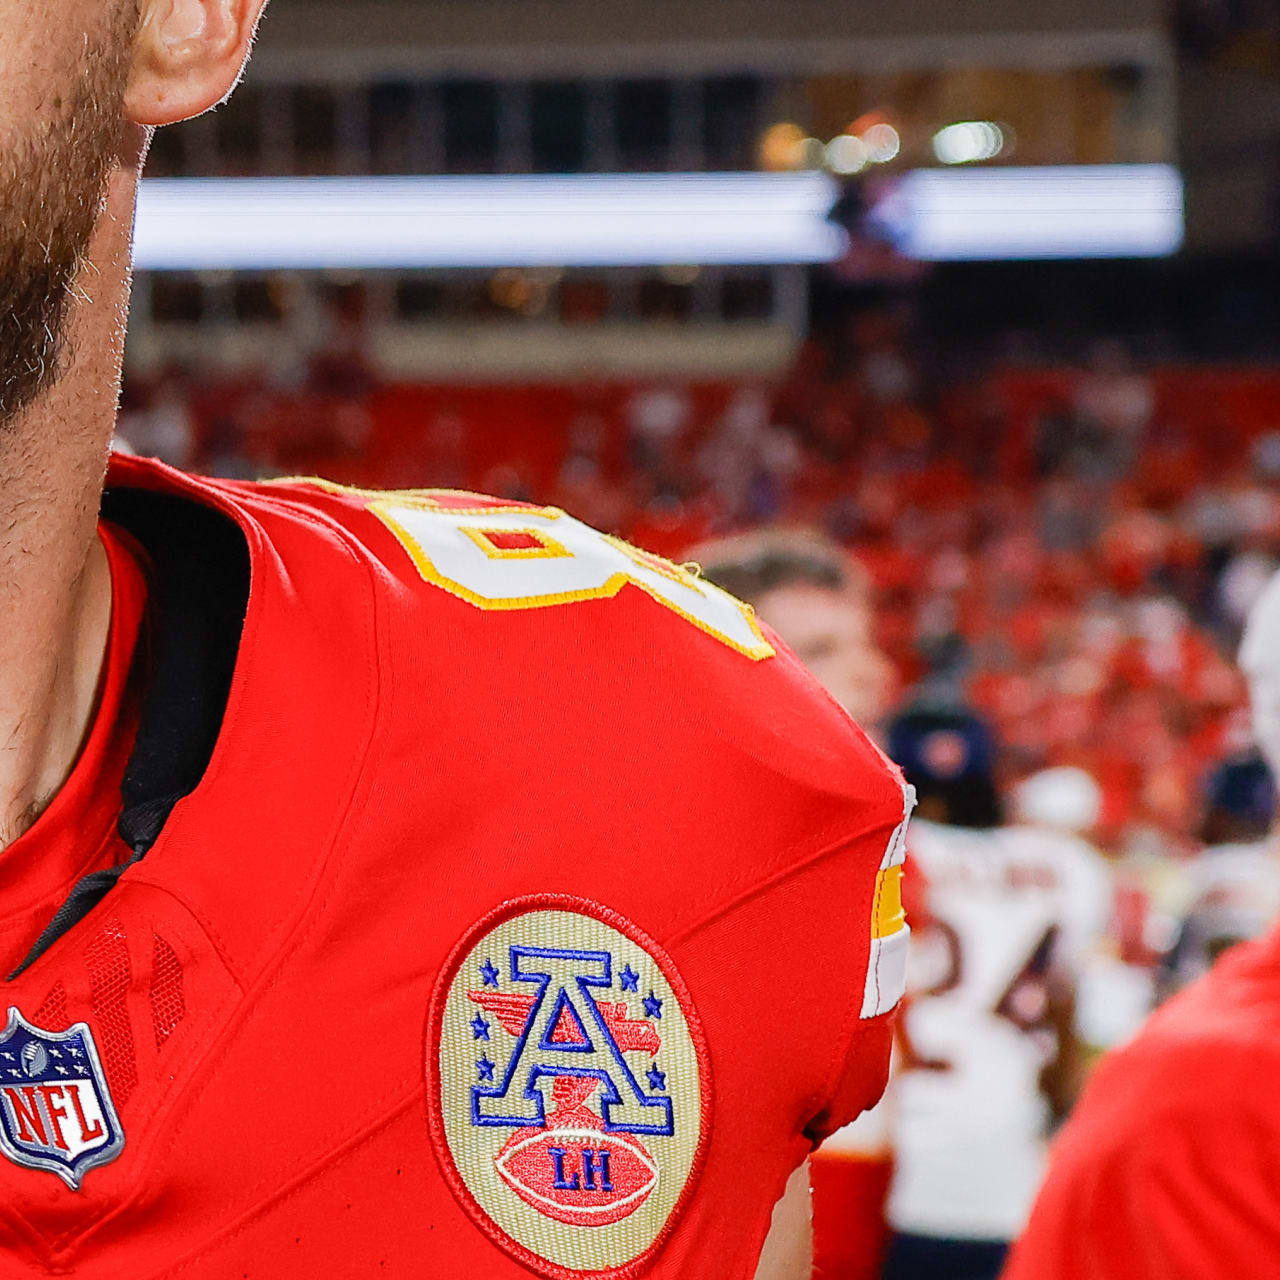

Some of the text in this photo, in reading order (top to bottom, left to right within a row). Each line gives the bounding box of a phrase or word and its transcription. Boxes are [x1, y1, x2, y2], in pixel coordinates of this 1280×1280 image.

[471, 944, 674, 1136] A
[2, 1084, 105, 1151] NFL
[548, 1147, 614, 1192] LH
